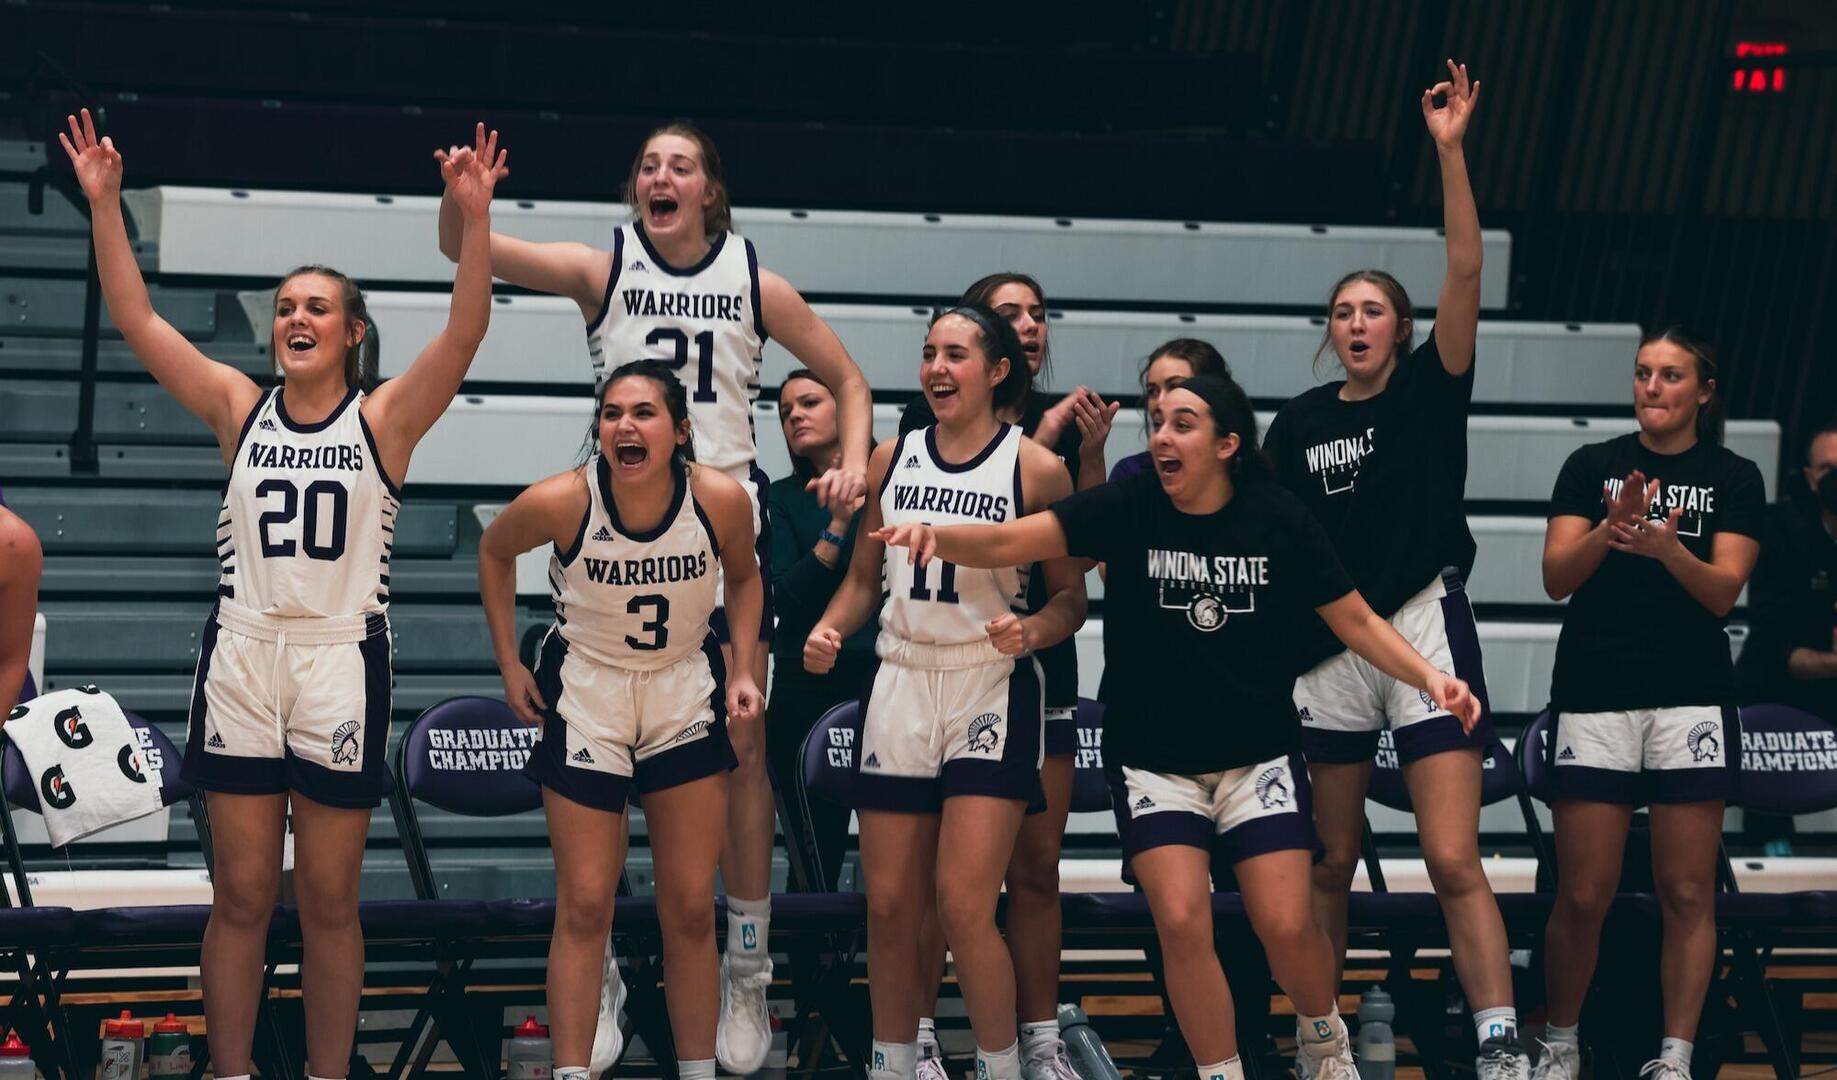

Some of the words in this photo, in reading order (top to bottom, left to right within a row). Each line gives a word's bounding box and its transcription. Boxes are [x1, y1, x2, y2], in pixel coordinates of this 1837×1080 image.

[622, 288, 743, 322] WARRIORS
[645, 327, 718, 404] 21
[247, 441, 363, 472] WARRIORS
[1305, 435, 1366, 474] WINONA
[893, 484, 1009, 523] WARRIORS
[1666, 484, 1714, 513] STATE
[255, 479, 349, 562] 20
[583, 550, 707, 586] WARRIORS
[1147, 548, 1211, 583] WINONA
[1214, 556, 1269, 585] STATE
[624, 593, 670, 650] 3
[1741, 730, 1837, 751] RADUATE
[428, 749, 532, 771] CHAMPIO
[1741, 749, 1837, 772] HAMPION
